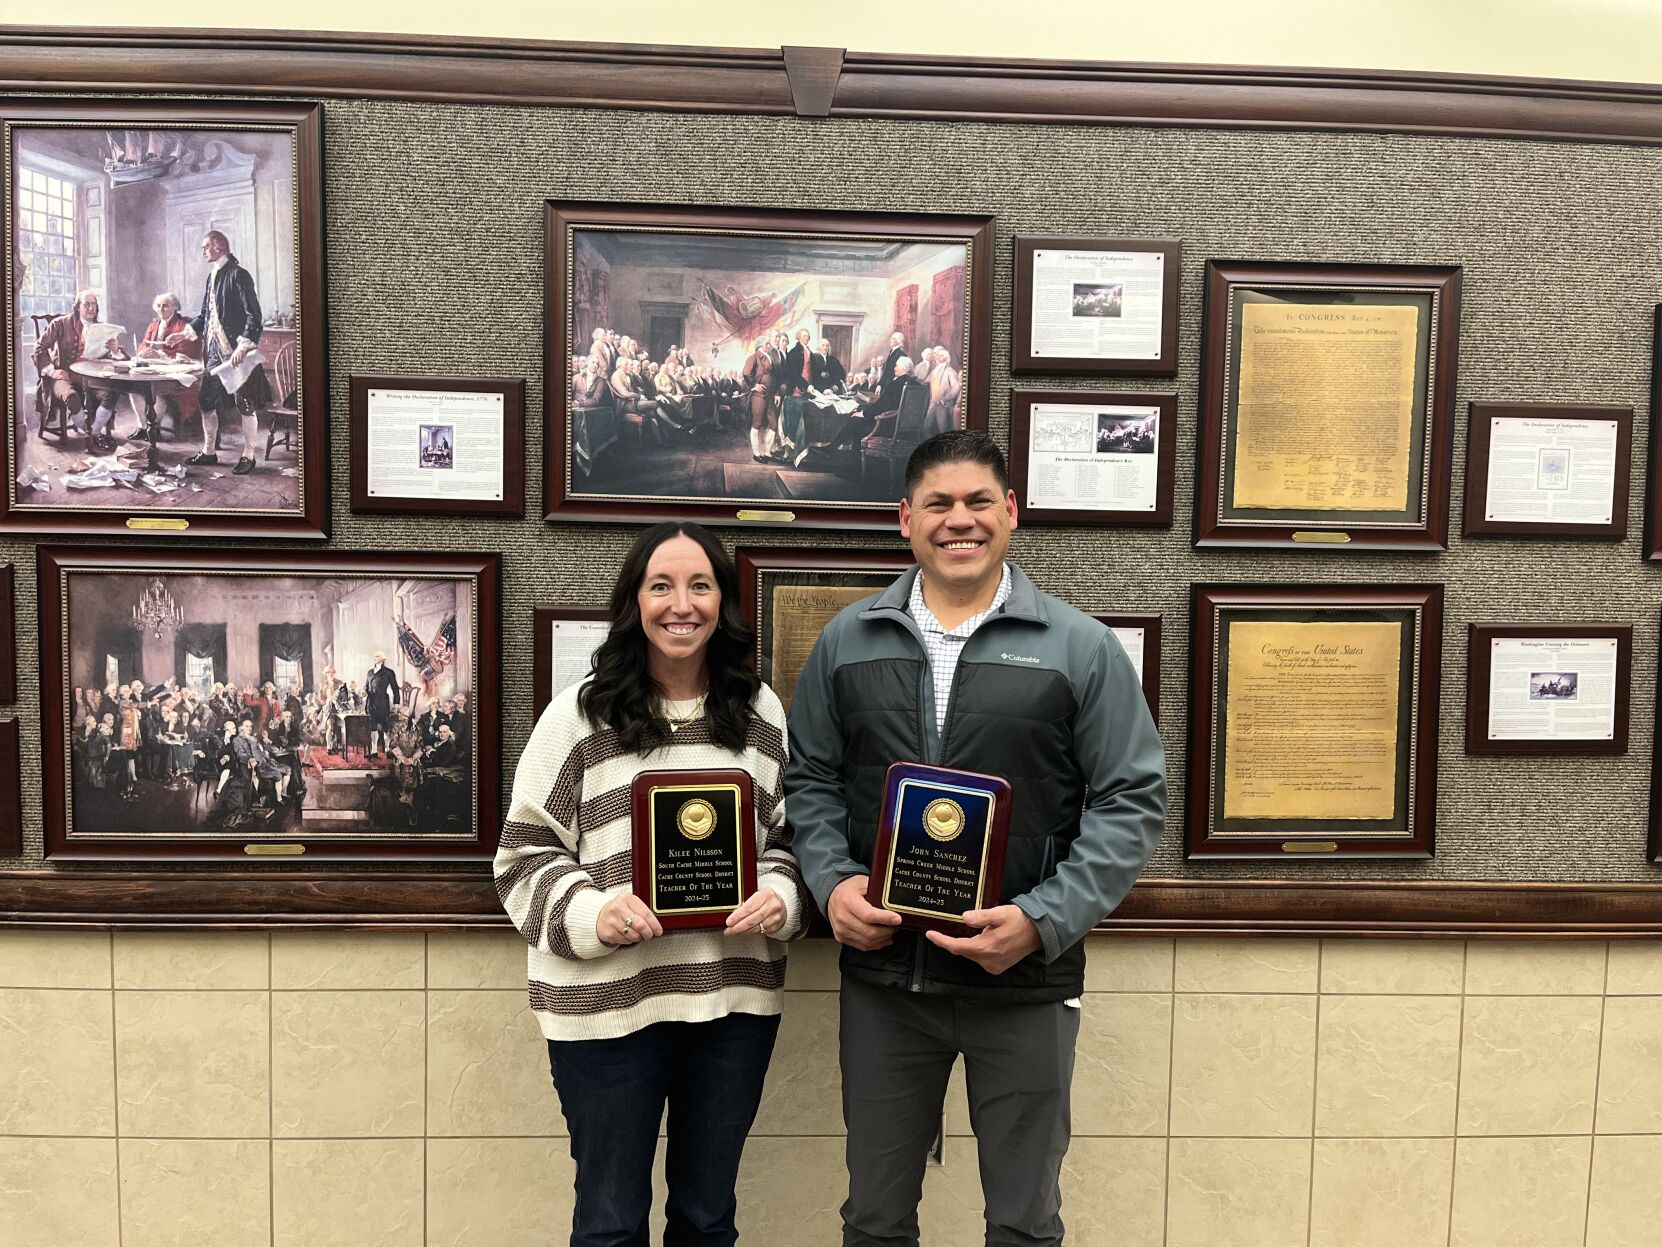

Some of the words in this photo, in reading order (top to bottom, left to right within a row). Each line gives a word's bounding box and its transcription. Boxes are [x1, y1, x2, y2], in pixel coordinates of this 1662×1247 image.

[1314, 644, 1339, 655] United
[1340, 645, 1364, 655] States
[1008, 654, 1039, 664] Columbia
